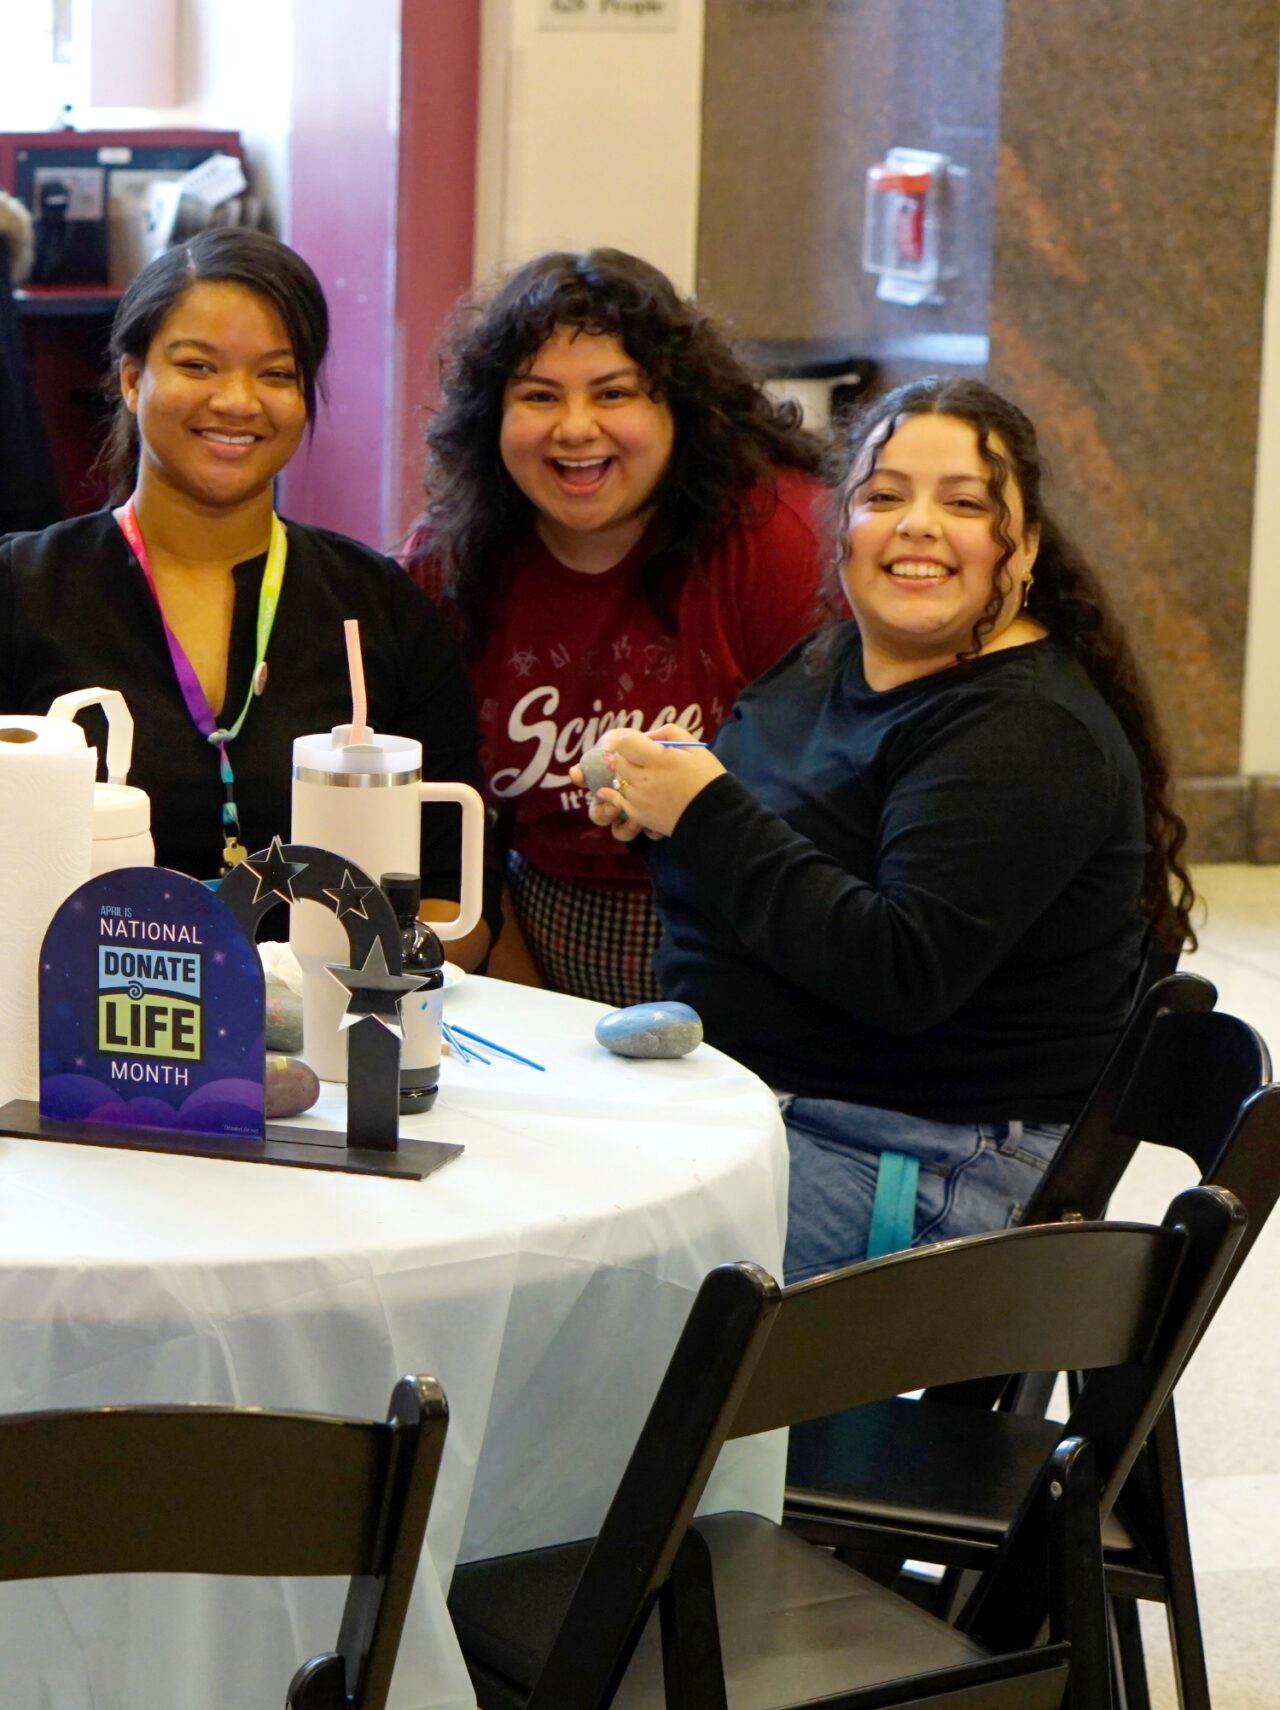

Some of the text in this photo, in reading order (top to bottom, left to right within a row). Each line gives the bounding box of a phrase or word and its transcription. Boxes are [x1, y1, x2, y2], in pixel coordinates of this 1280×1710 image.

[100, 905, 133, 918] APRIL IS
[100, 917, 203, 945] NATIONAL
[104, 951, 196, 983] DONATE
[105, 1001, 196, 1053] LIFE
[111, 1060, 189, 1087] MONTH
